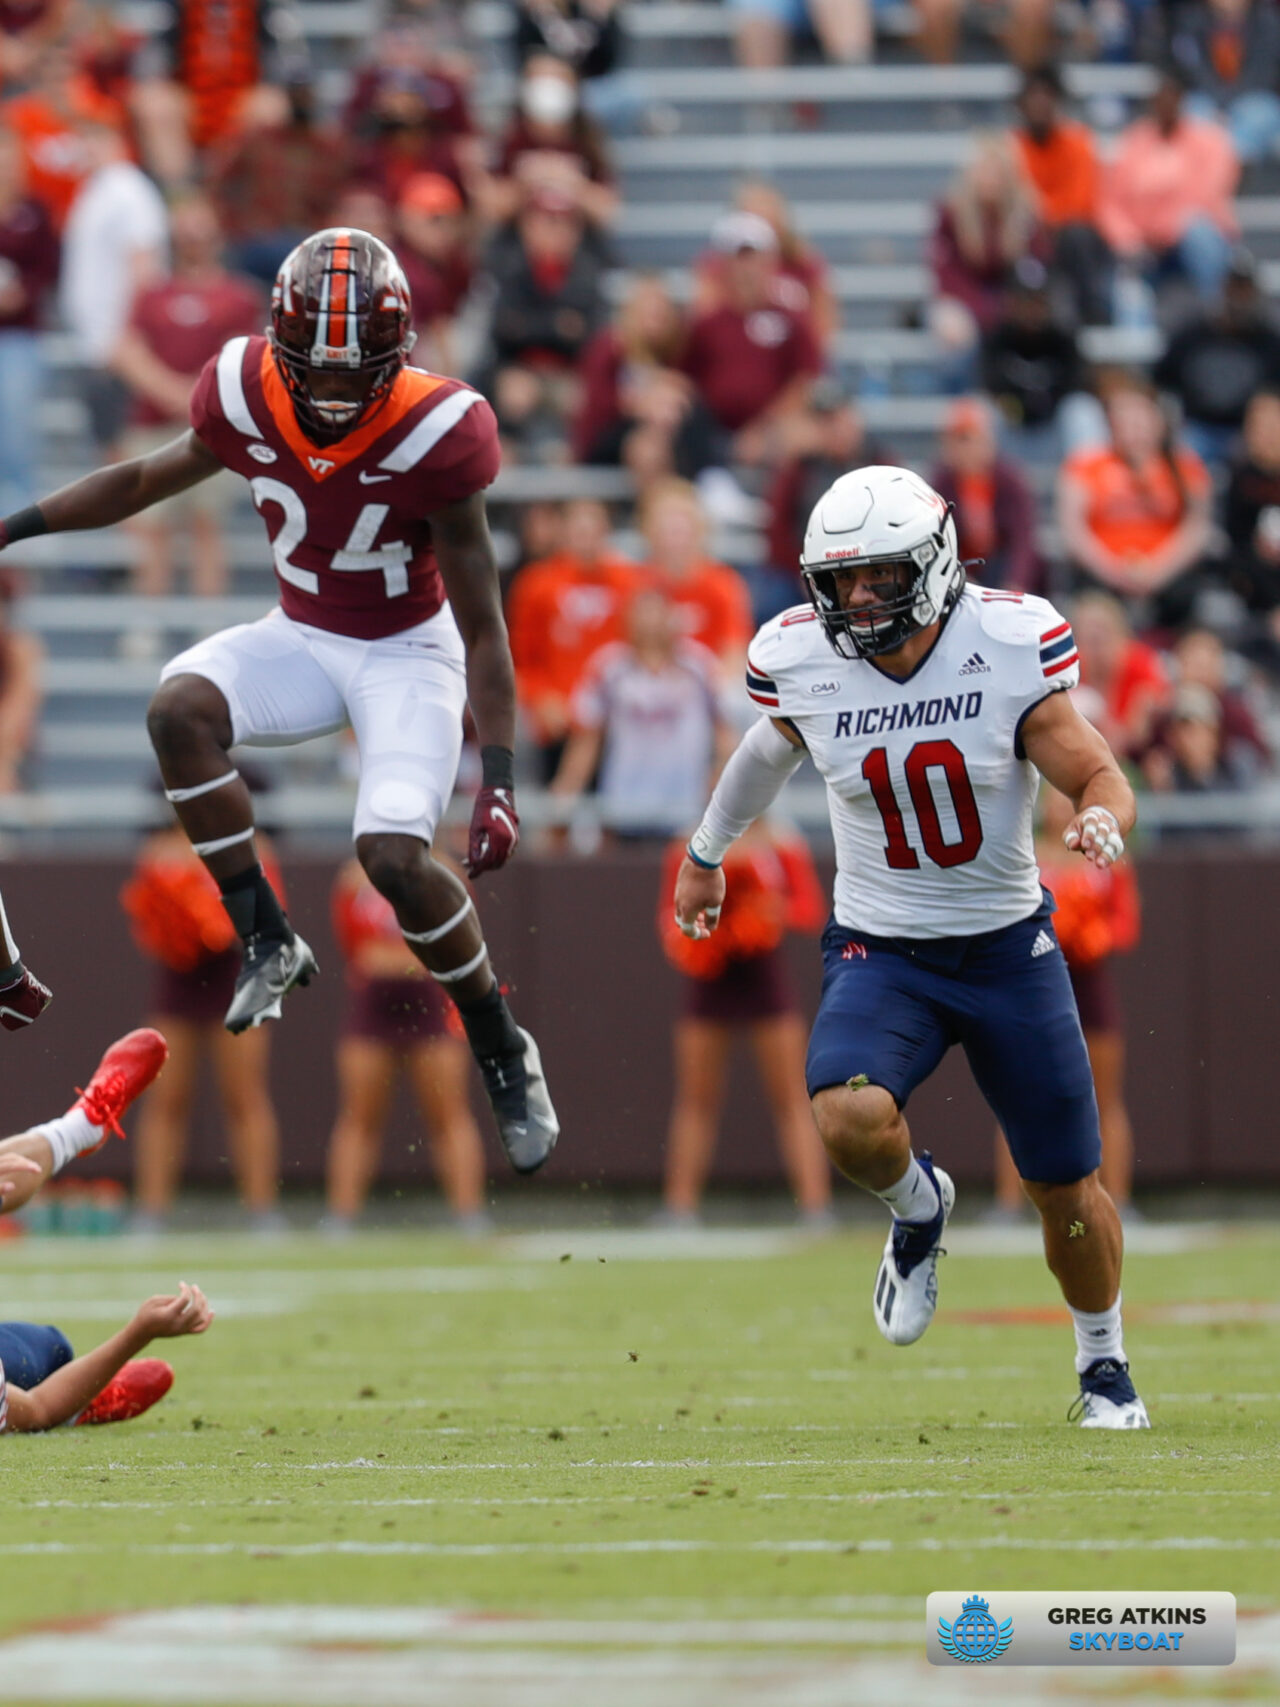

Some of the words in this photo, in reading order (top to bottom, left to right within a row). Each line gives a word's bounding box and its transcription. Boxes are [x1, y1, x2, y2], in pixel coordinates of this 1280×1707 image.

[307, 456, 335, 474] VT
[251, 476, 413, 598] 24
[825, 548, 860, 560] Riddell
[959, 665, 991, 676] adidas
[811, 682, 836, 693] CAA
[833, 691, 983, 739] RICHMOND
[861, 738, 984, 870] 10
